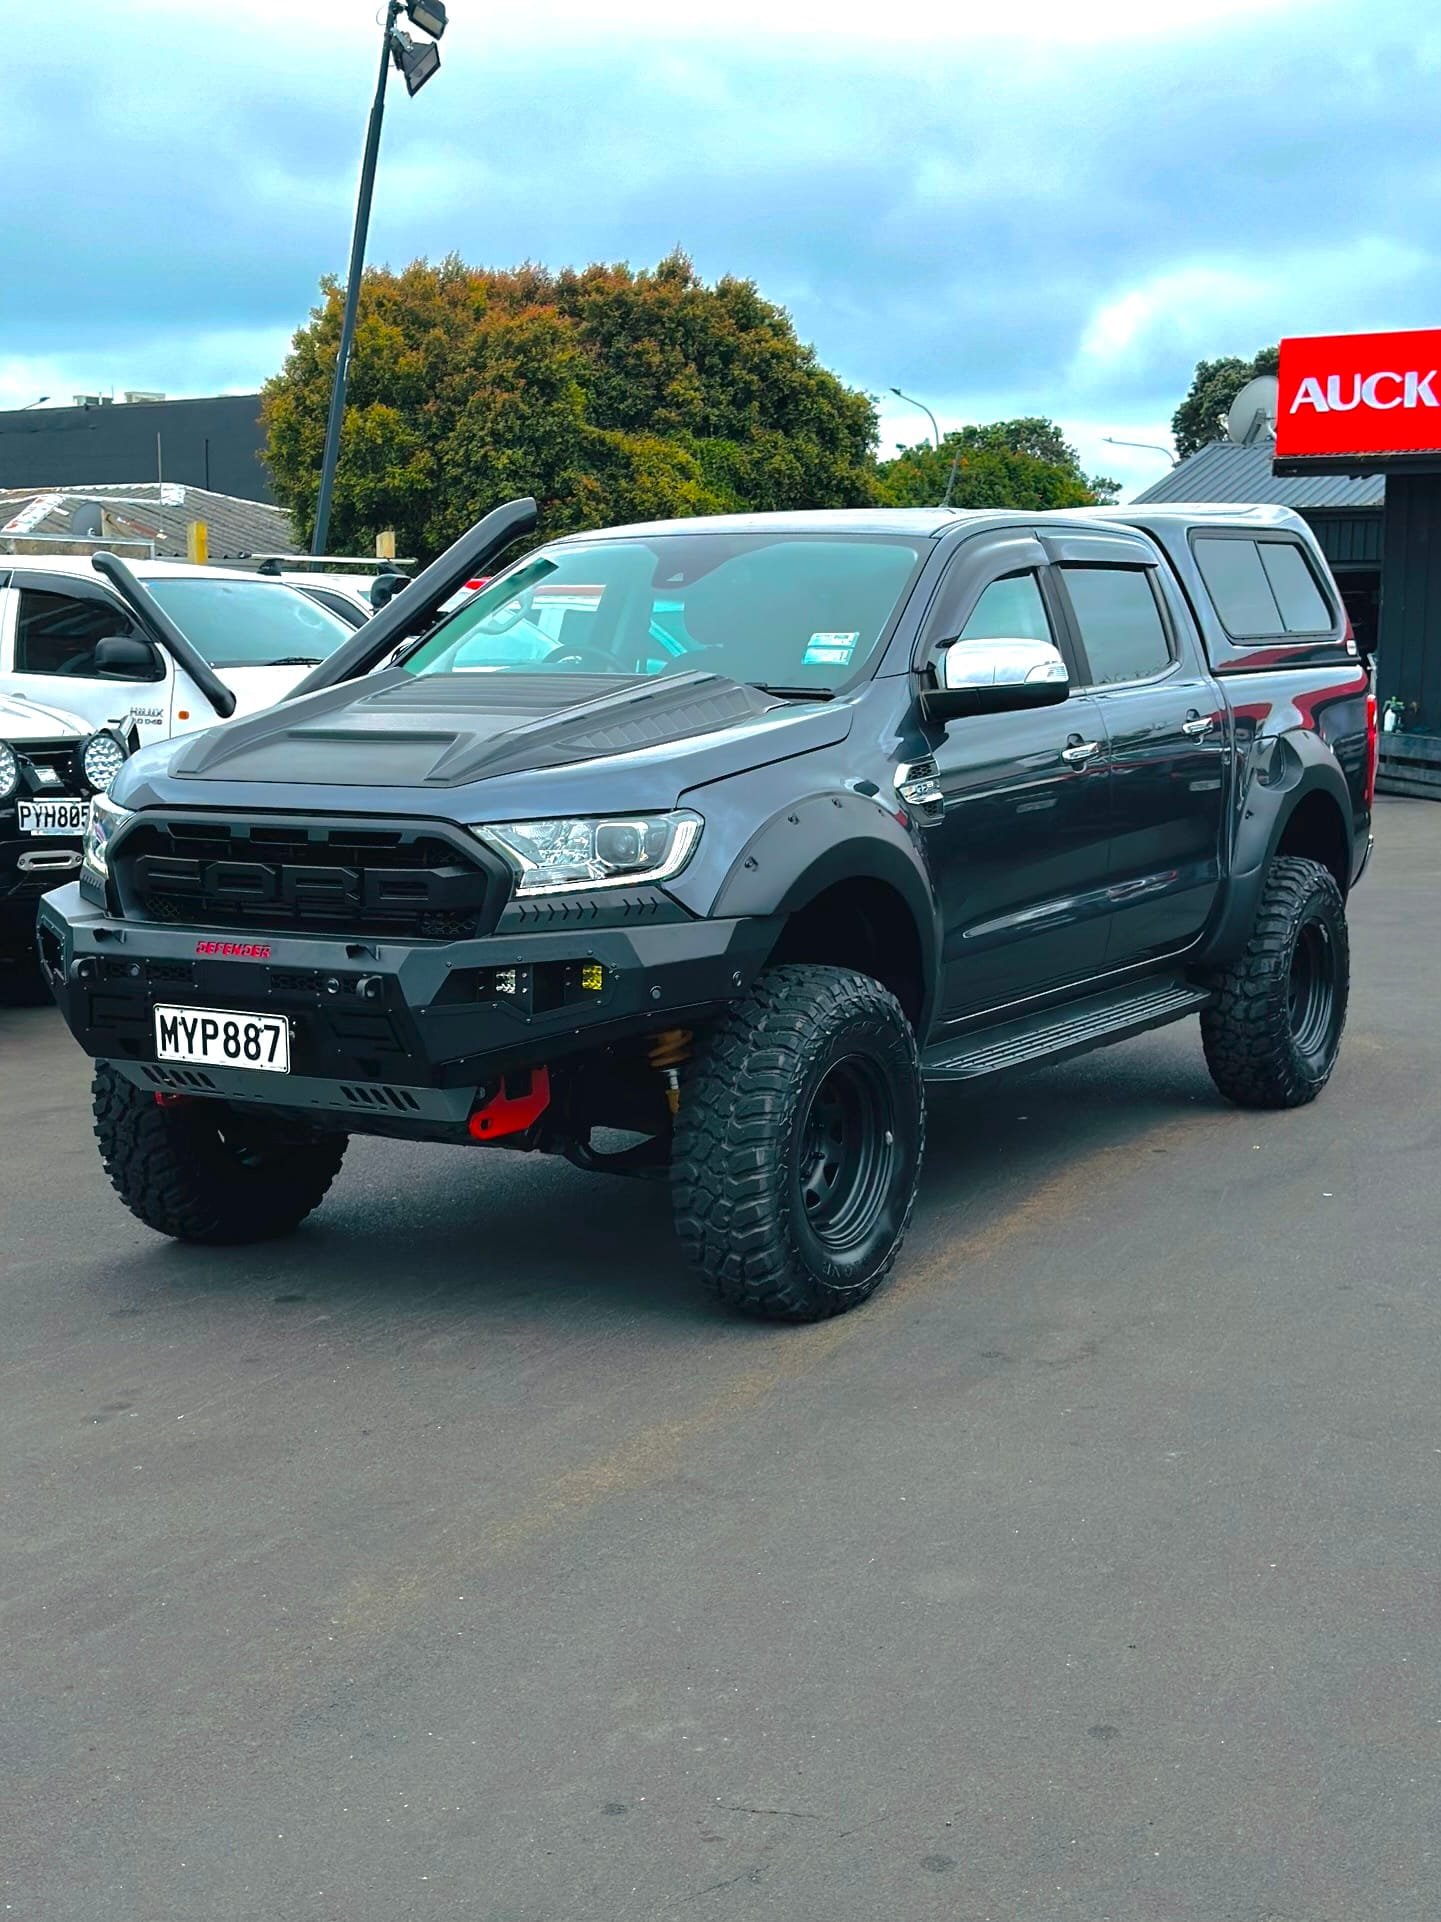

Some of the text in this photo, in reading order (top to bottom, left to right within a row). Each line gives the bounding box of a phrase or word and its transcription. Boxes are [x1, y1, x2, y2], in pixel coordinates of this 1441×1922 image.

[1289, 370, 1440, 414] AUCK
[196, 941, 270, 957] DEFENDER
[159, 1014, 280, 1062] MYP887
